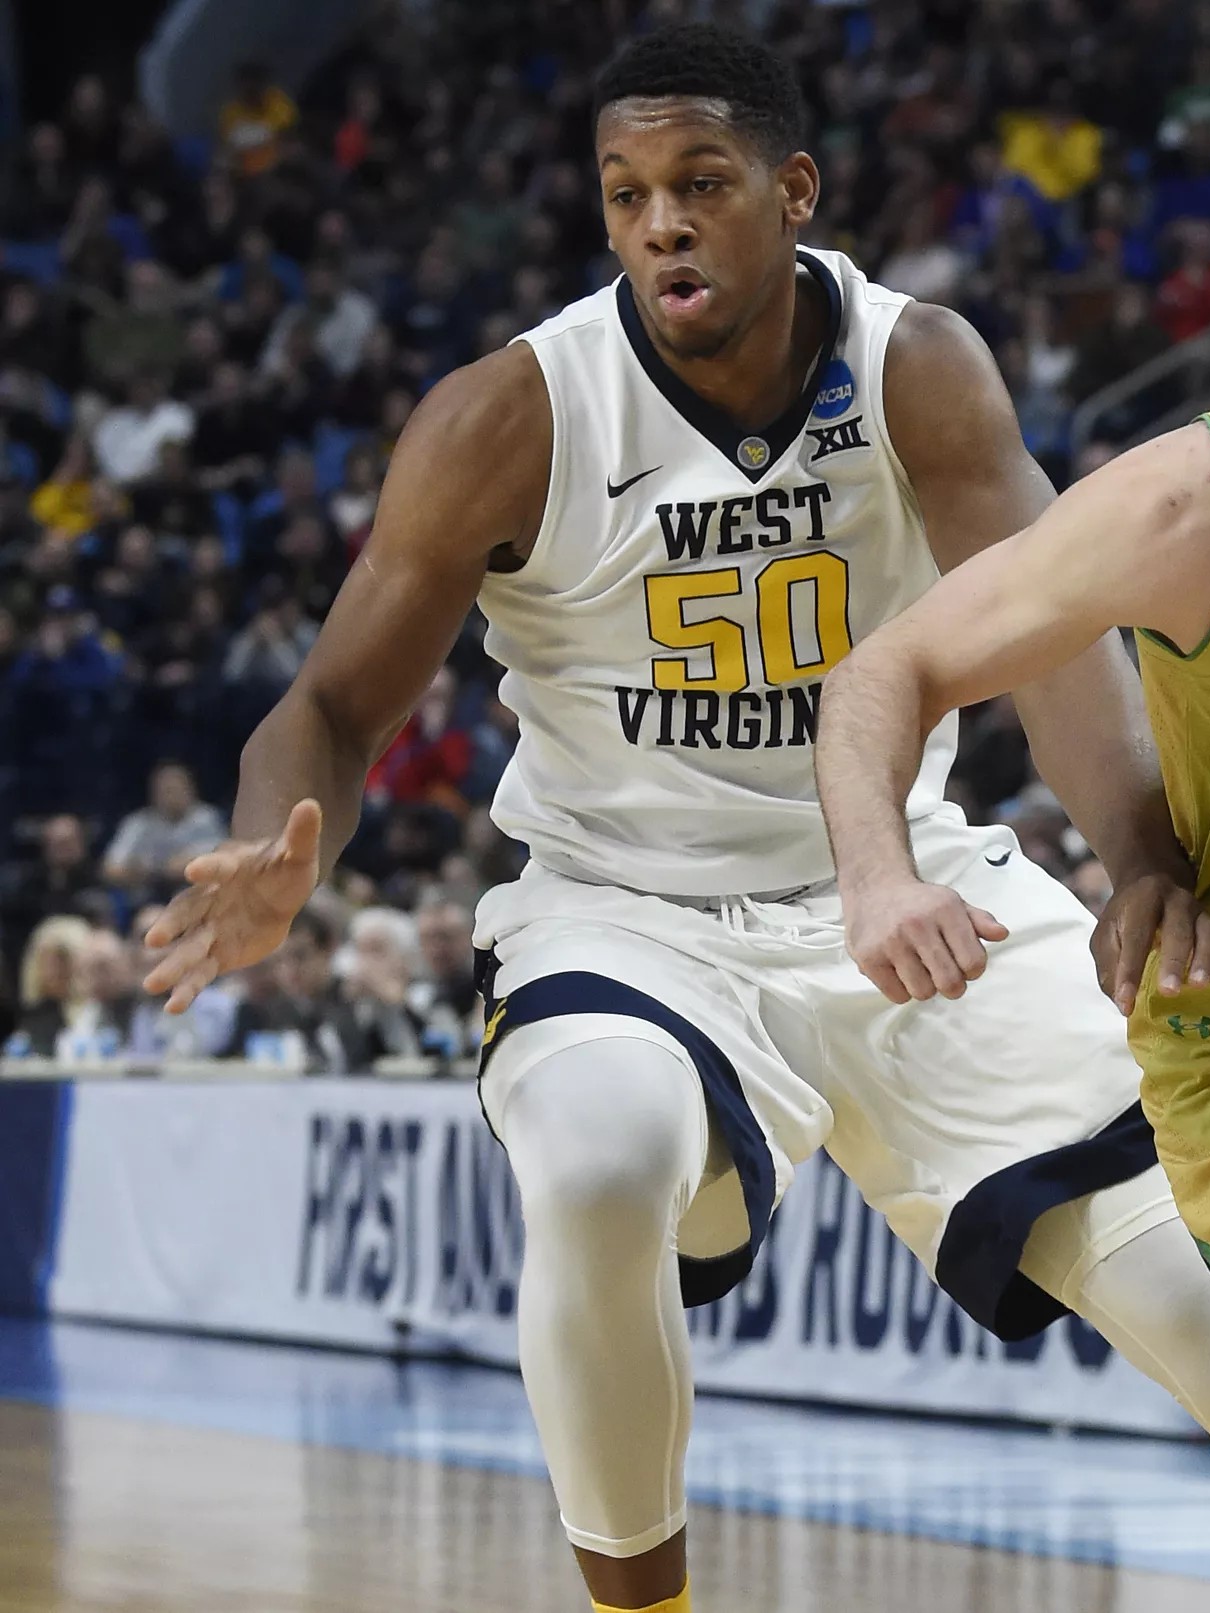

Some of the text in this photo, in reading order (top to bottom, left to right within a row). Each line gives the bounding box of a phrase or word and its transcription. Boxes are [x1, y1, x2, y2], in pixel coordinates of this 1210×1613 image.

[815, 383, 852, 405] NCAA
[655, 483, 832, 561] WEST
[643, 550, 853, 693] 50
